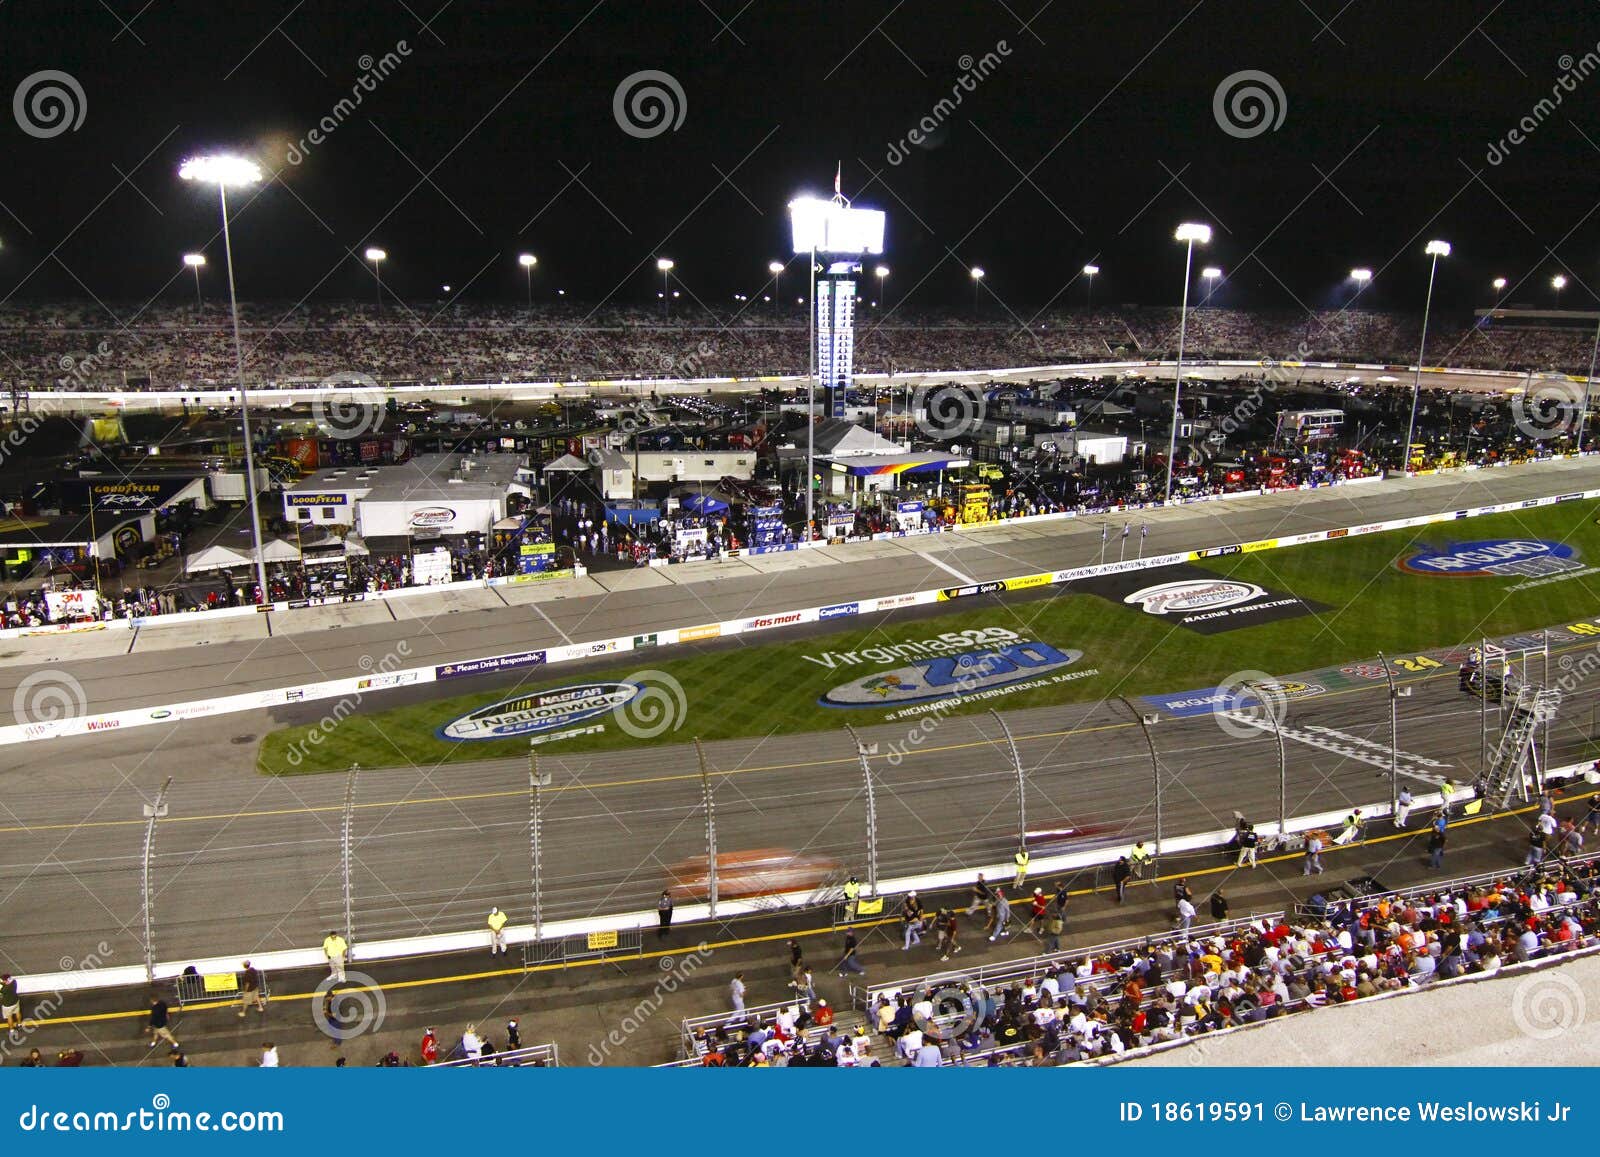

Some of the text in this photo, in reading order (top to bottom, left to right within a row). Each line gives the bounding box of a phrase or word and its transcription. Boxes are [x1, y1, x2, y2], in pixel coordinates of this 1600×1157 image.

[95, 483, 160, 494] GOODYEAR
[292, 495, 342, 504] GOODYEAR
[1057, 554, 1181, 580] RICHMOND INTERNATIONAL RACEWAY
[980, 583, 997, 593] Sprint
[62, 593, 83, 602] 3M
[754, 613, 801, 629] fas mart
[1183, 610, 1230, 623] RACING
[802, 627, 1019, 668] Virginia529
[456, 663, 480, 673] Please
[480, 659, 500, 669] Drink
[1394, 656, 1444, 672] 24
[539, 687, 602, 706] NASCAR
[899, 696, 963, 719] RICHMOND
[964, 679, 1052, 703] INTERNATIONAL
[1053, 668, 1100, 685] RACEWAY
[481, 691, 628, 727] Nationwide
[87, 719, 120, 731] Wawa
[502, 714, 570, 733] SERIES
[530, 724, 606, 746] ESPN
